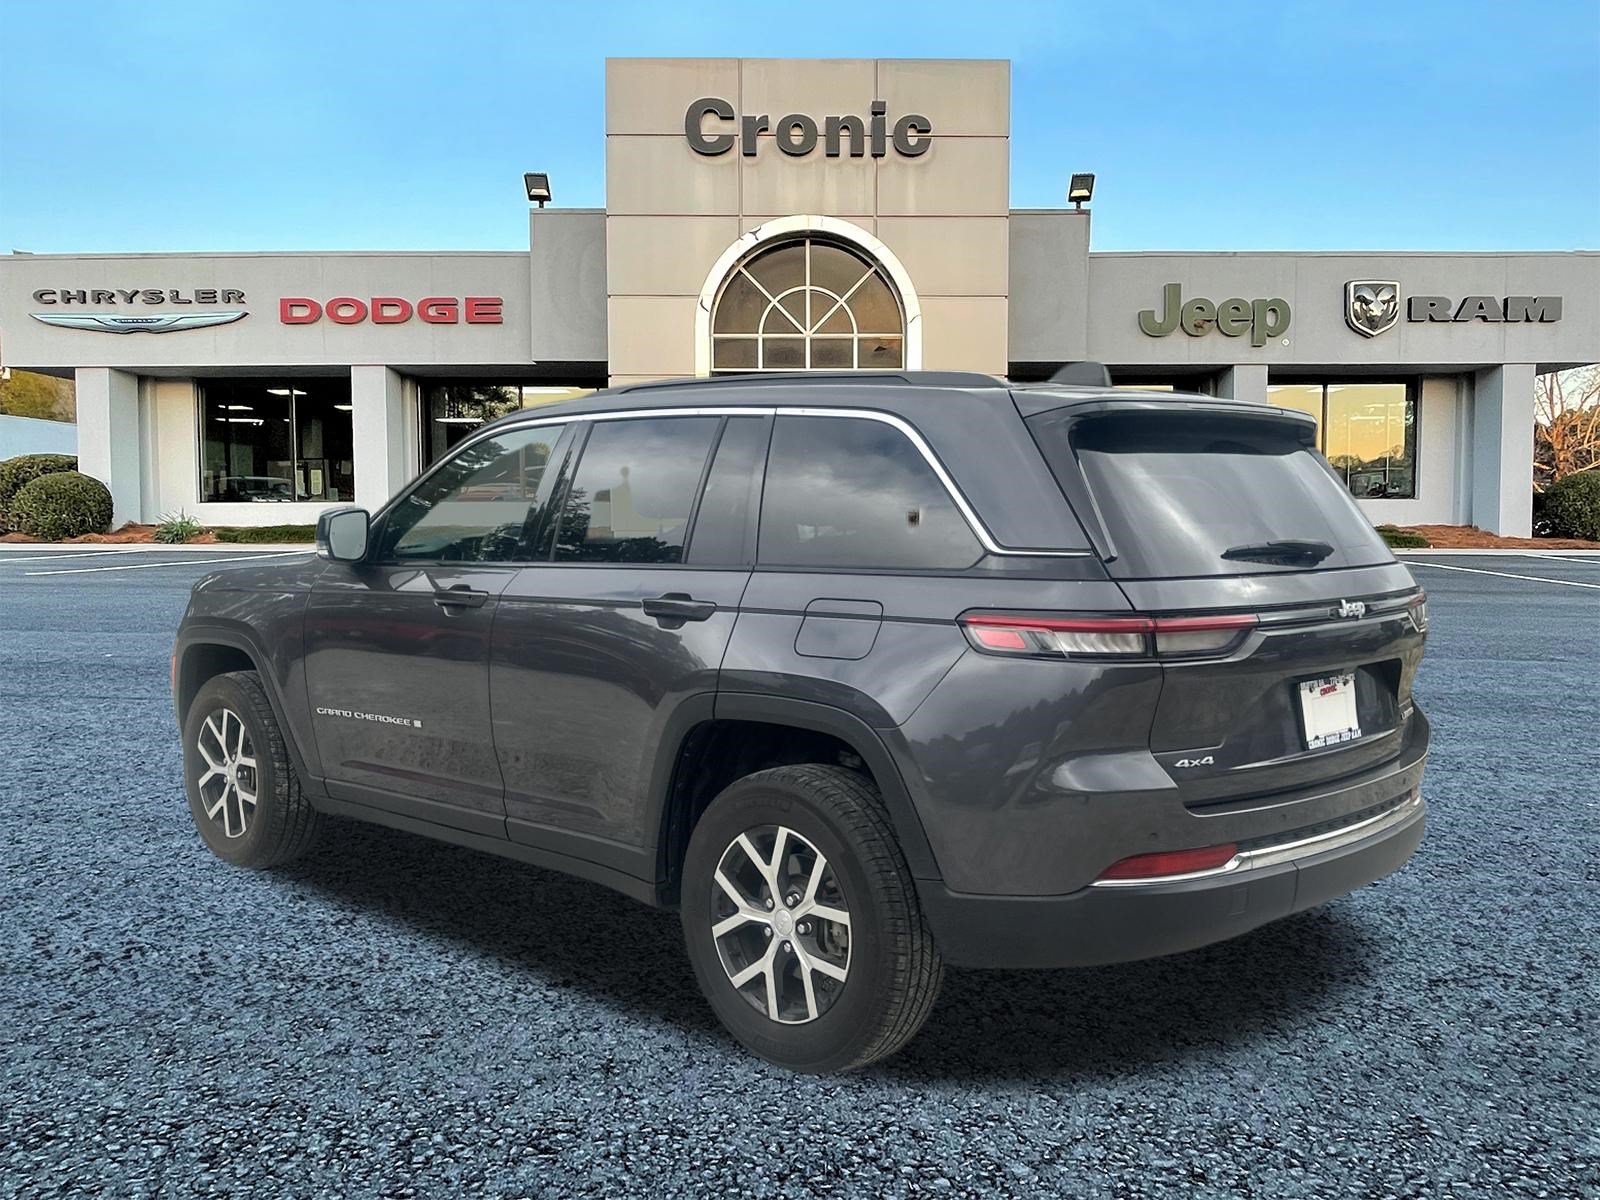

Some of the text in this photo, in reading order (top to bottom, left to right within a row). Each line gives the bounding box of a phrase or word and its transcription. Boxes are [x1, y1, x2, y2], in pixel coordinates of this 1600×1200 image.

[685, 97, 932, 157] Cronic
[32, 288, 246, 304] CHRYSLER
[279, 297, 503, 324] DODGE
[1138, 283, 1291, 347] Jeep
[1407, 296, 1562, 322] RAM
[1338, 599, 1365, 618] Jeep
[316, 707, 411, 726] GRAND CHEROKEE
[1174, 756, 1214, 767] 4x4
